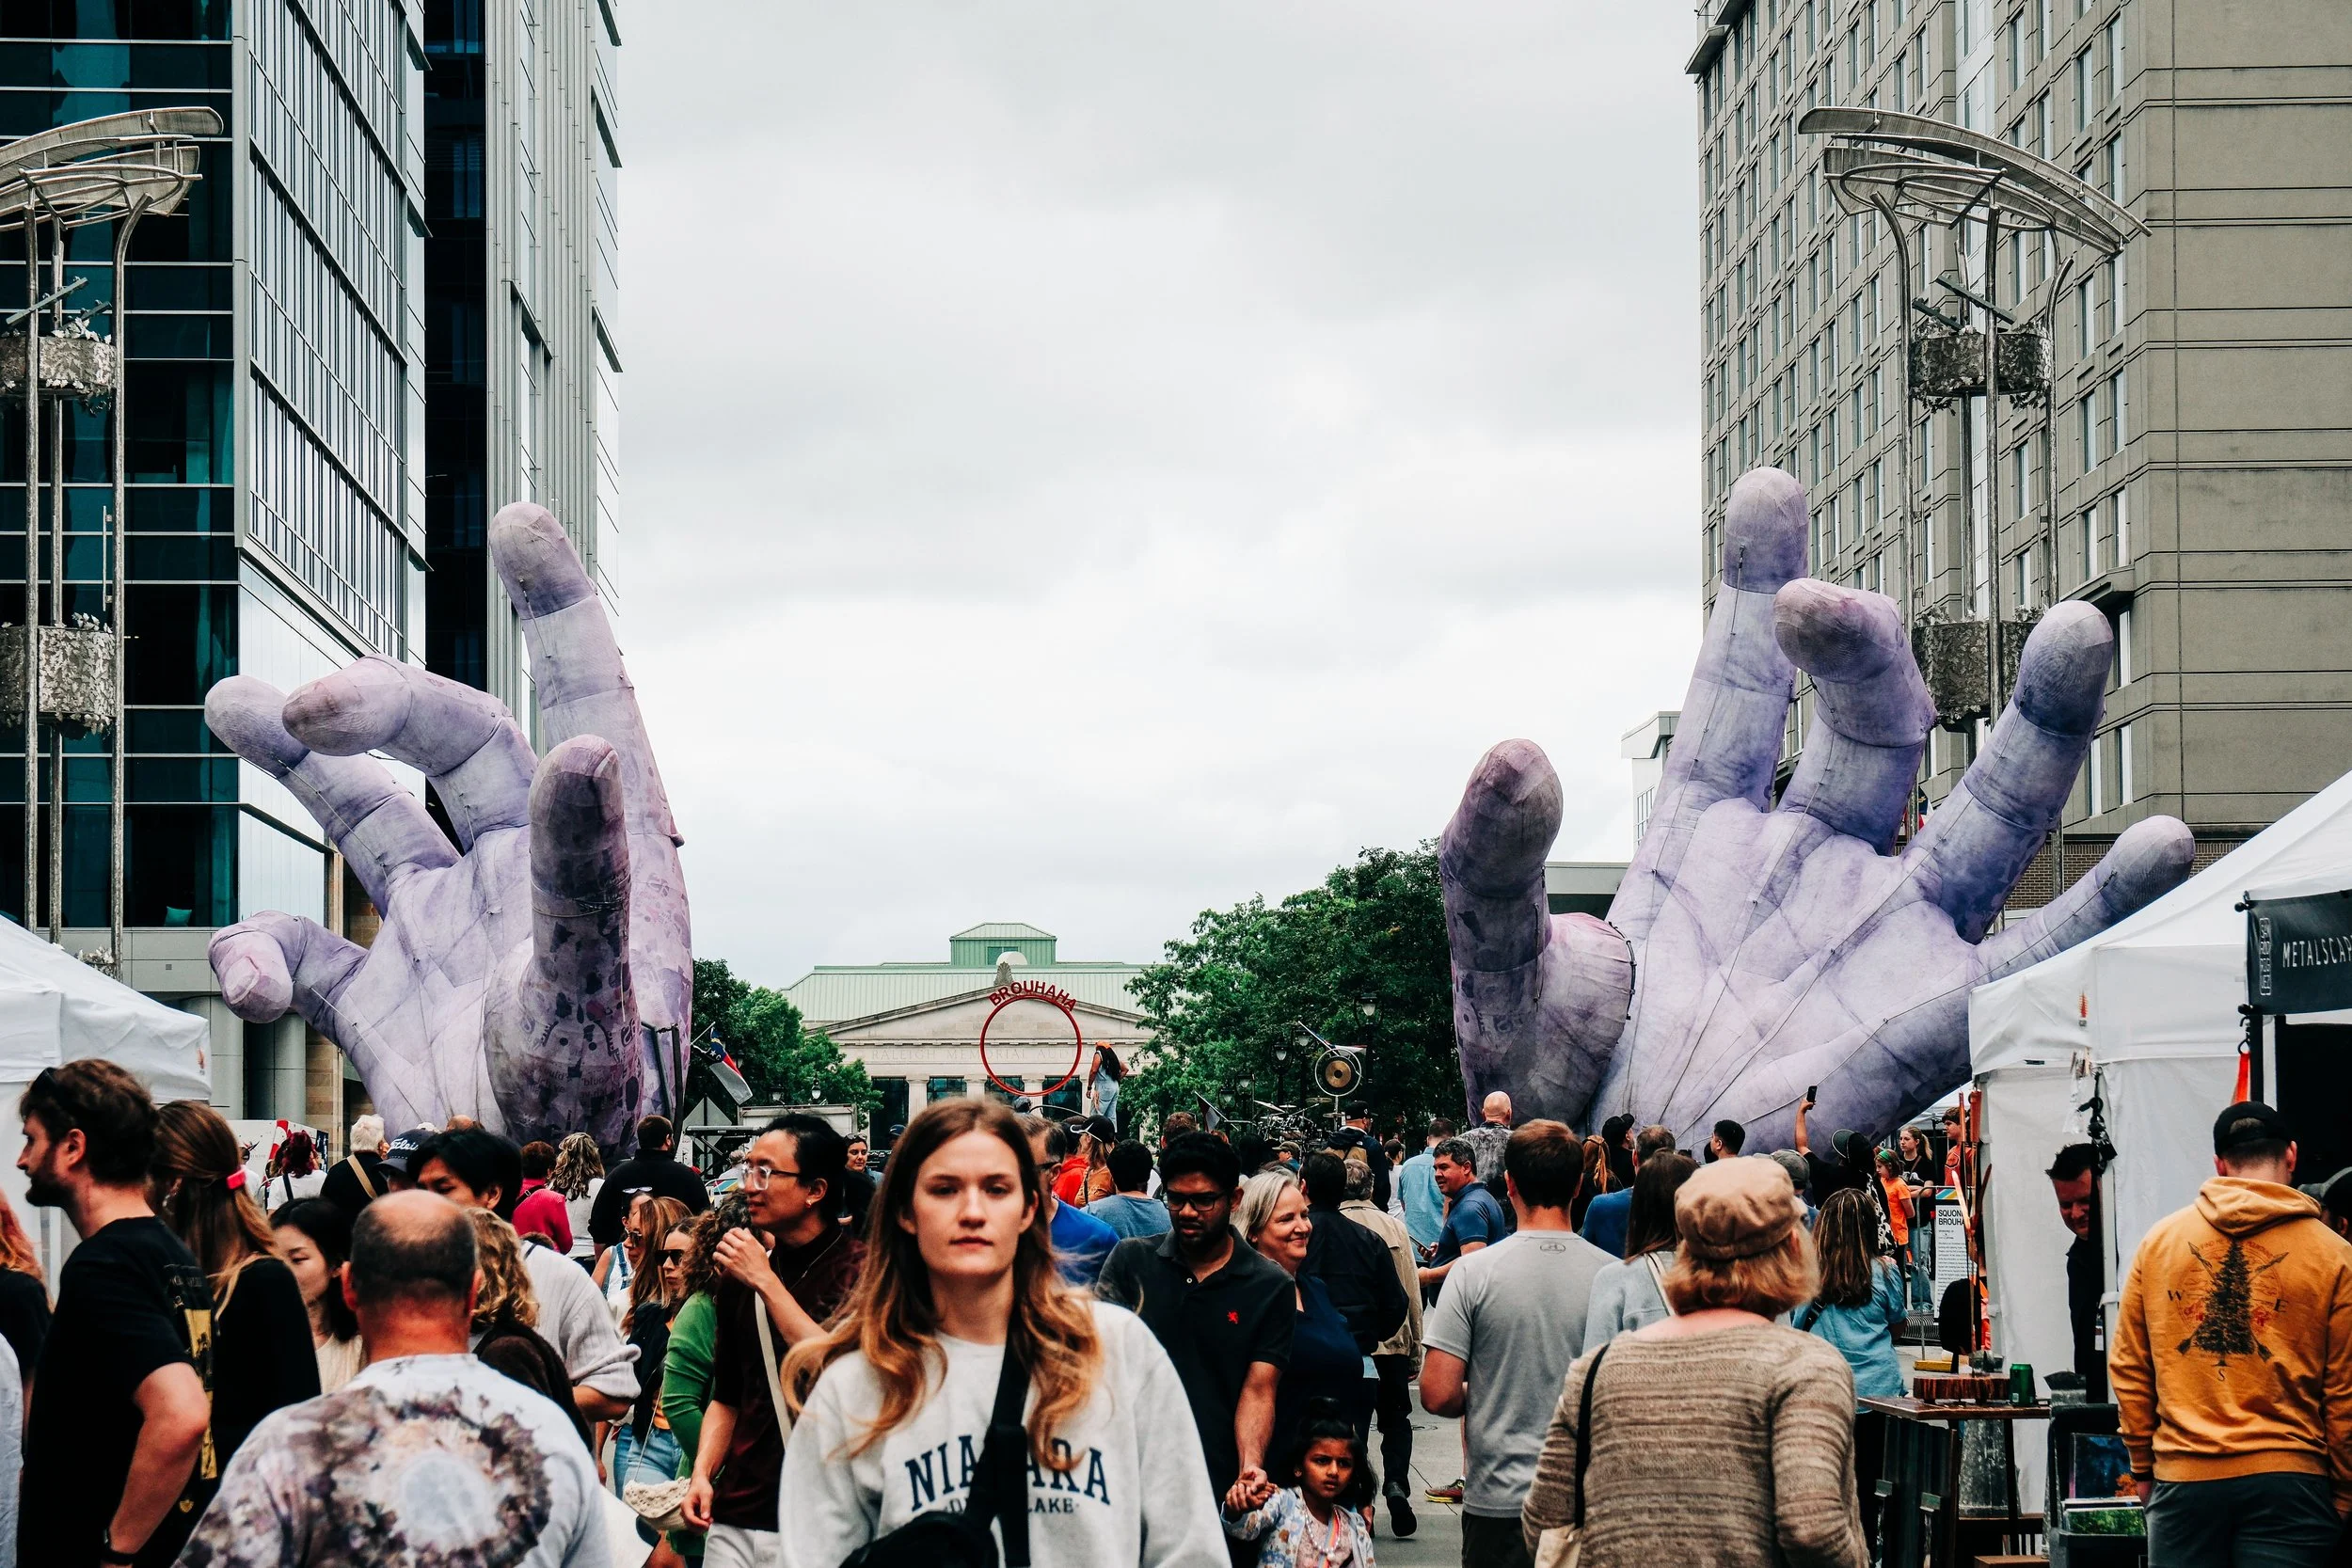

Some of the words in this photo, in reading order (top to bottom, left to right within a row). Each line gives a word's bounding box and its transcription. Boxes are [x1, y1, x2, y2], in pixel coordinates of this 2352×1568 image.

[2282, 934, 2352, 968] METALSCAP
[988, 980, 1077, 1012] BROUHAHA
[871, 1048, 936, 1060] RALEIGH
[1938, 1209, 1963, 1217] SQUON
[1938, 1217, 1964, 1226] BROUHA
[2167, 1290, 2184, 1302] W
[2273, 1298, 2290, 1313] E
[2217, 1369, 2226, 1382] S
[904, 1434, 1112, 1512] NIAARA
[1028, 1497, 1074, 1513] AKE
